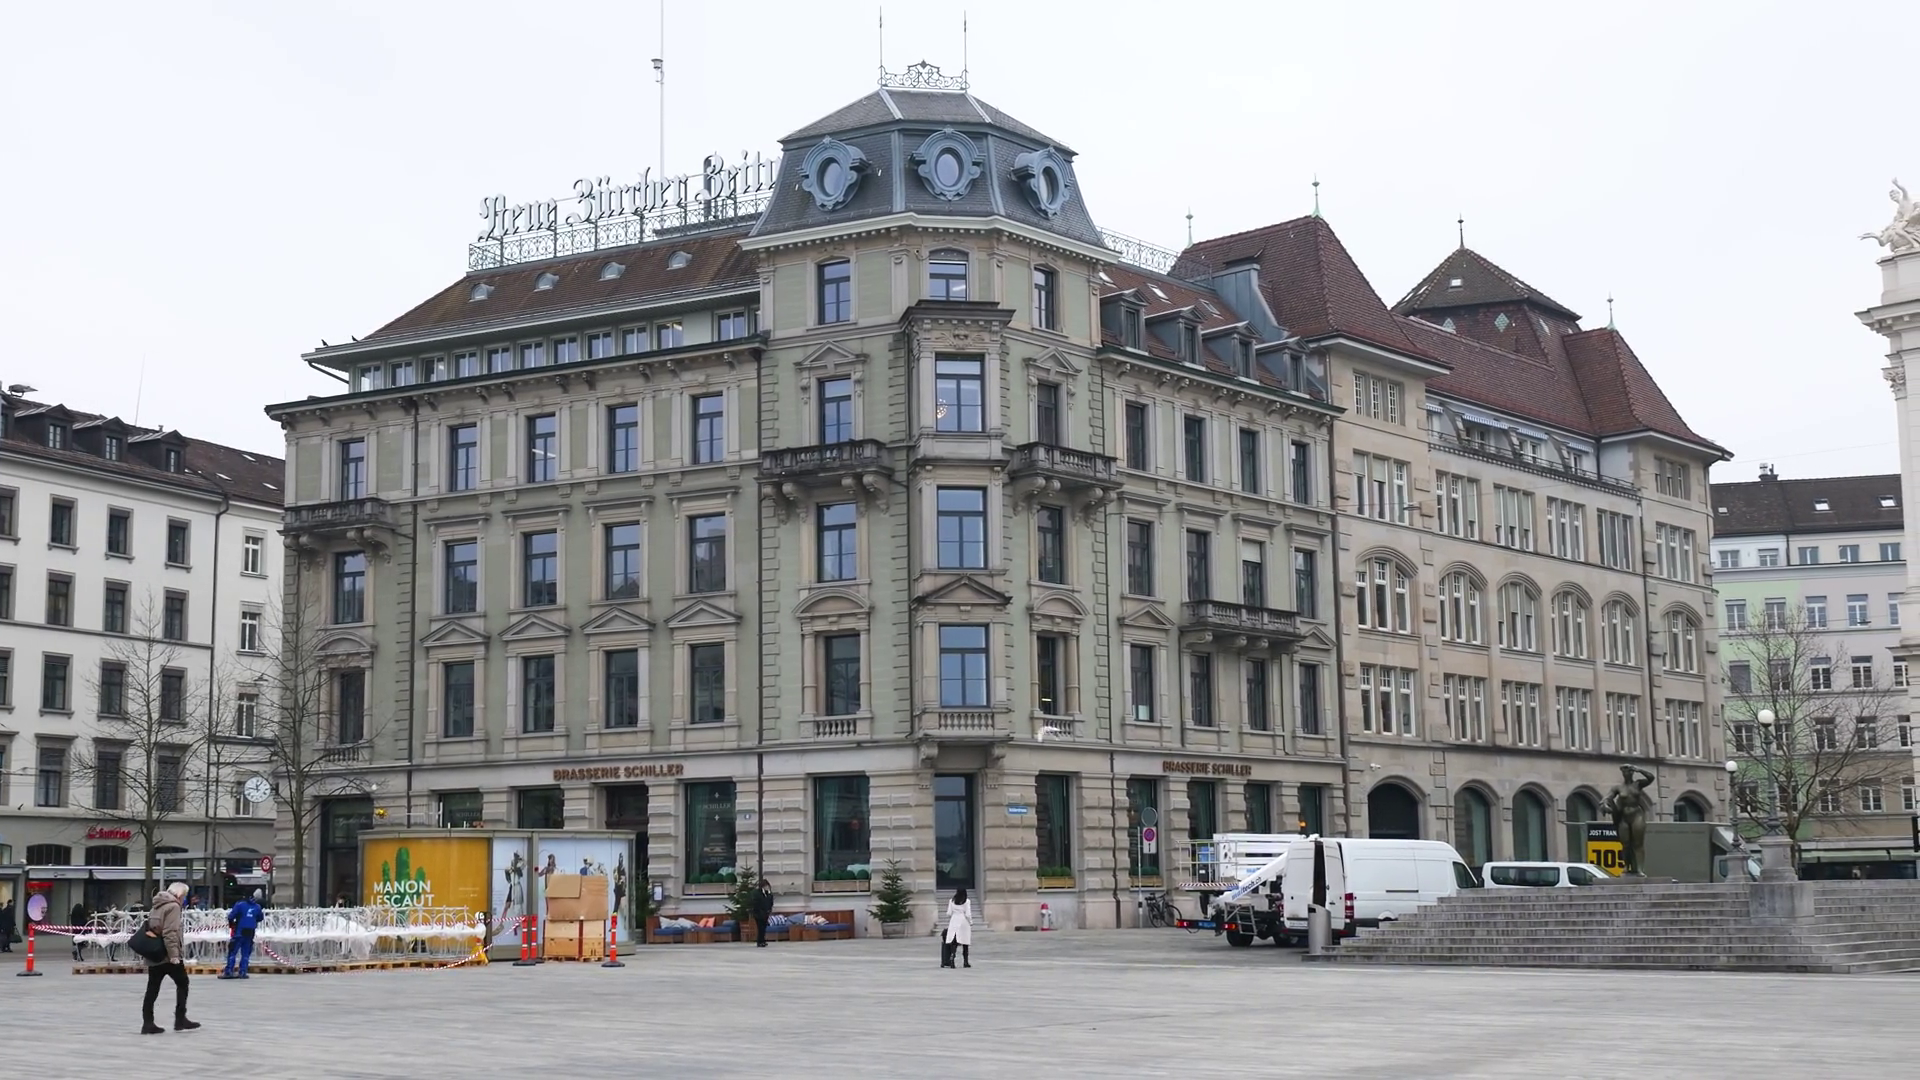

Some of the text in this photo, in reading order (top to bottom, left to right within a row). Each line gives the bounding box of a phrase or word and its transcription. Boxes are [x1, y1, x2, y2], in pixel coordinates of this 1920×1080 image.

[478, 149, 783, 242] Neue Zürcher Zeitu
[553, 763, 684, 781] BRASSERIE SCHILLER
[1162, 760, 1252, 777] BRASSERIE SCHILLER
[1602, 829, 1618, 837] TRAN
[1590, 849, 1625, 868] JOS
[373, 880, 431, 894] MANON
[370, 894, 435, 907] LESCAUT
